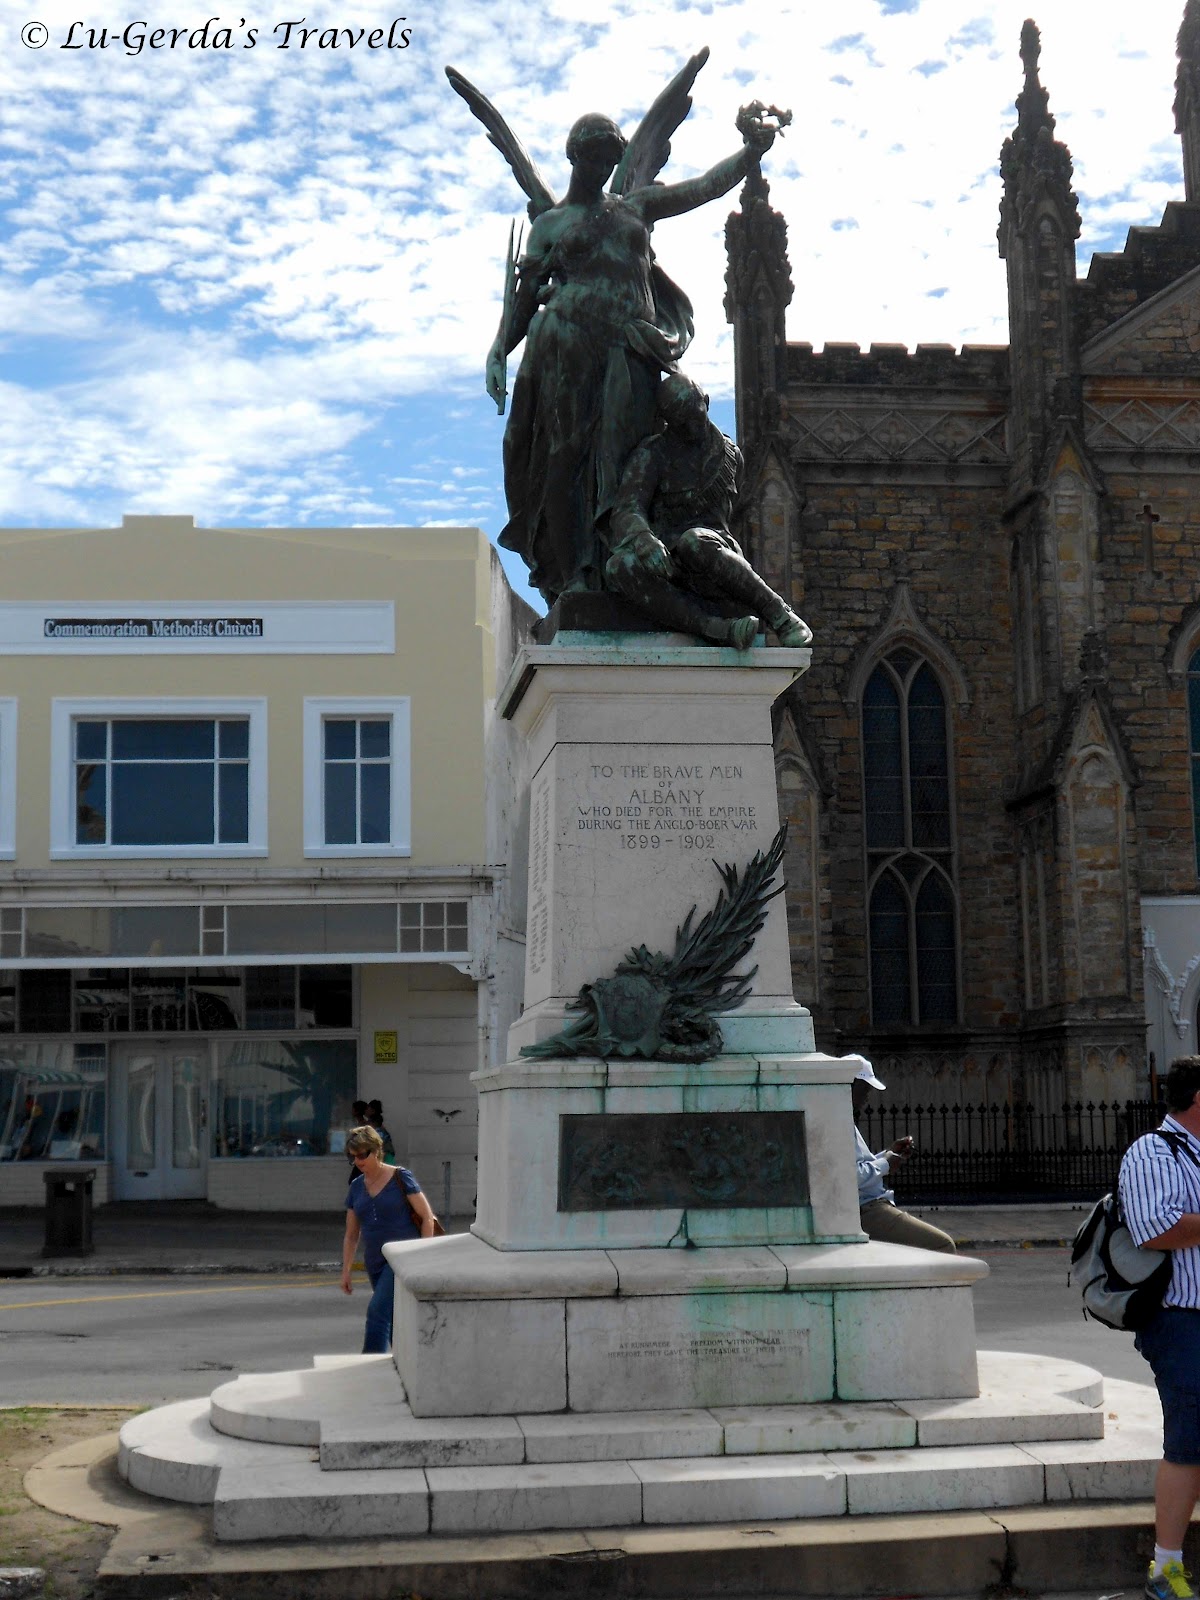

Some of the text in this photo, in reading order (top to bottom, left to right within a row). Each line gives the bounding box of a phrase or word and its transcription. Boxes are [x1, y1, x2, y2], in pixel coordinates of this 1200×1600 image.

[44, 619, 260, 637] Commemoration Methodist Church
[591, 765, 743, 779] TO THE BRAVE MEN
[658, 780, 673, 788] OF
[629, 789, 705, 804] ALBANY
[578, 806, 756, 817] WHO DIED FOR THE EMPIRE
[578, 819, 758, 830] DURING THE ANGLO-BOER WAR
